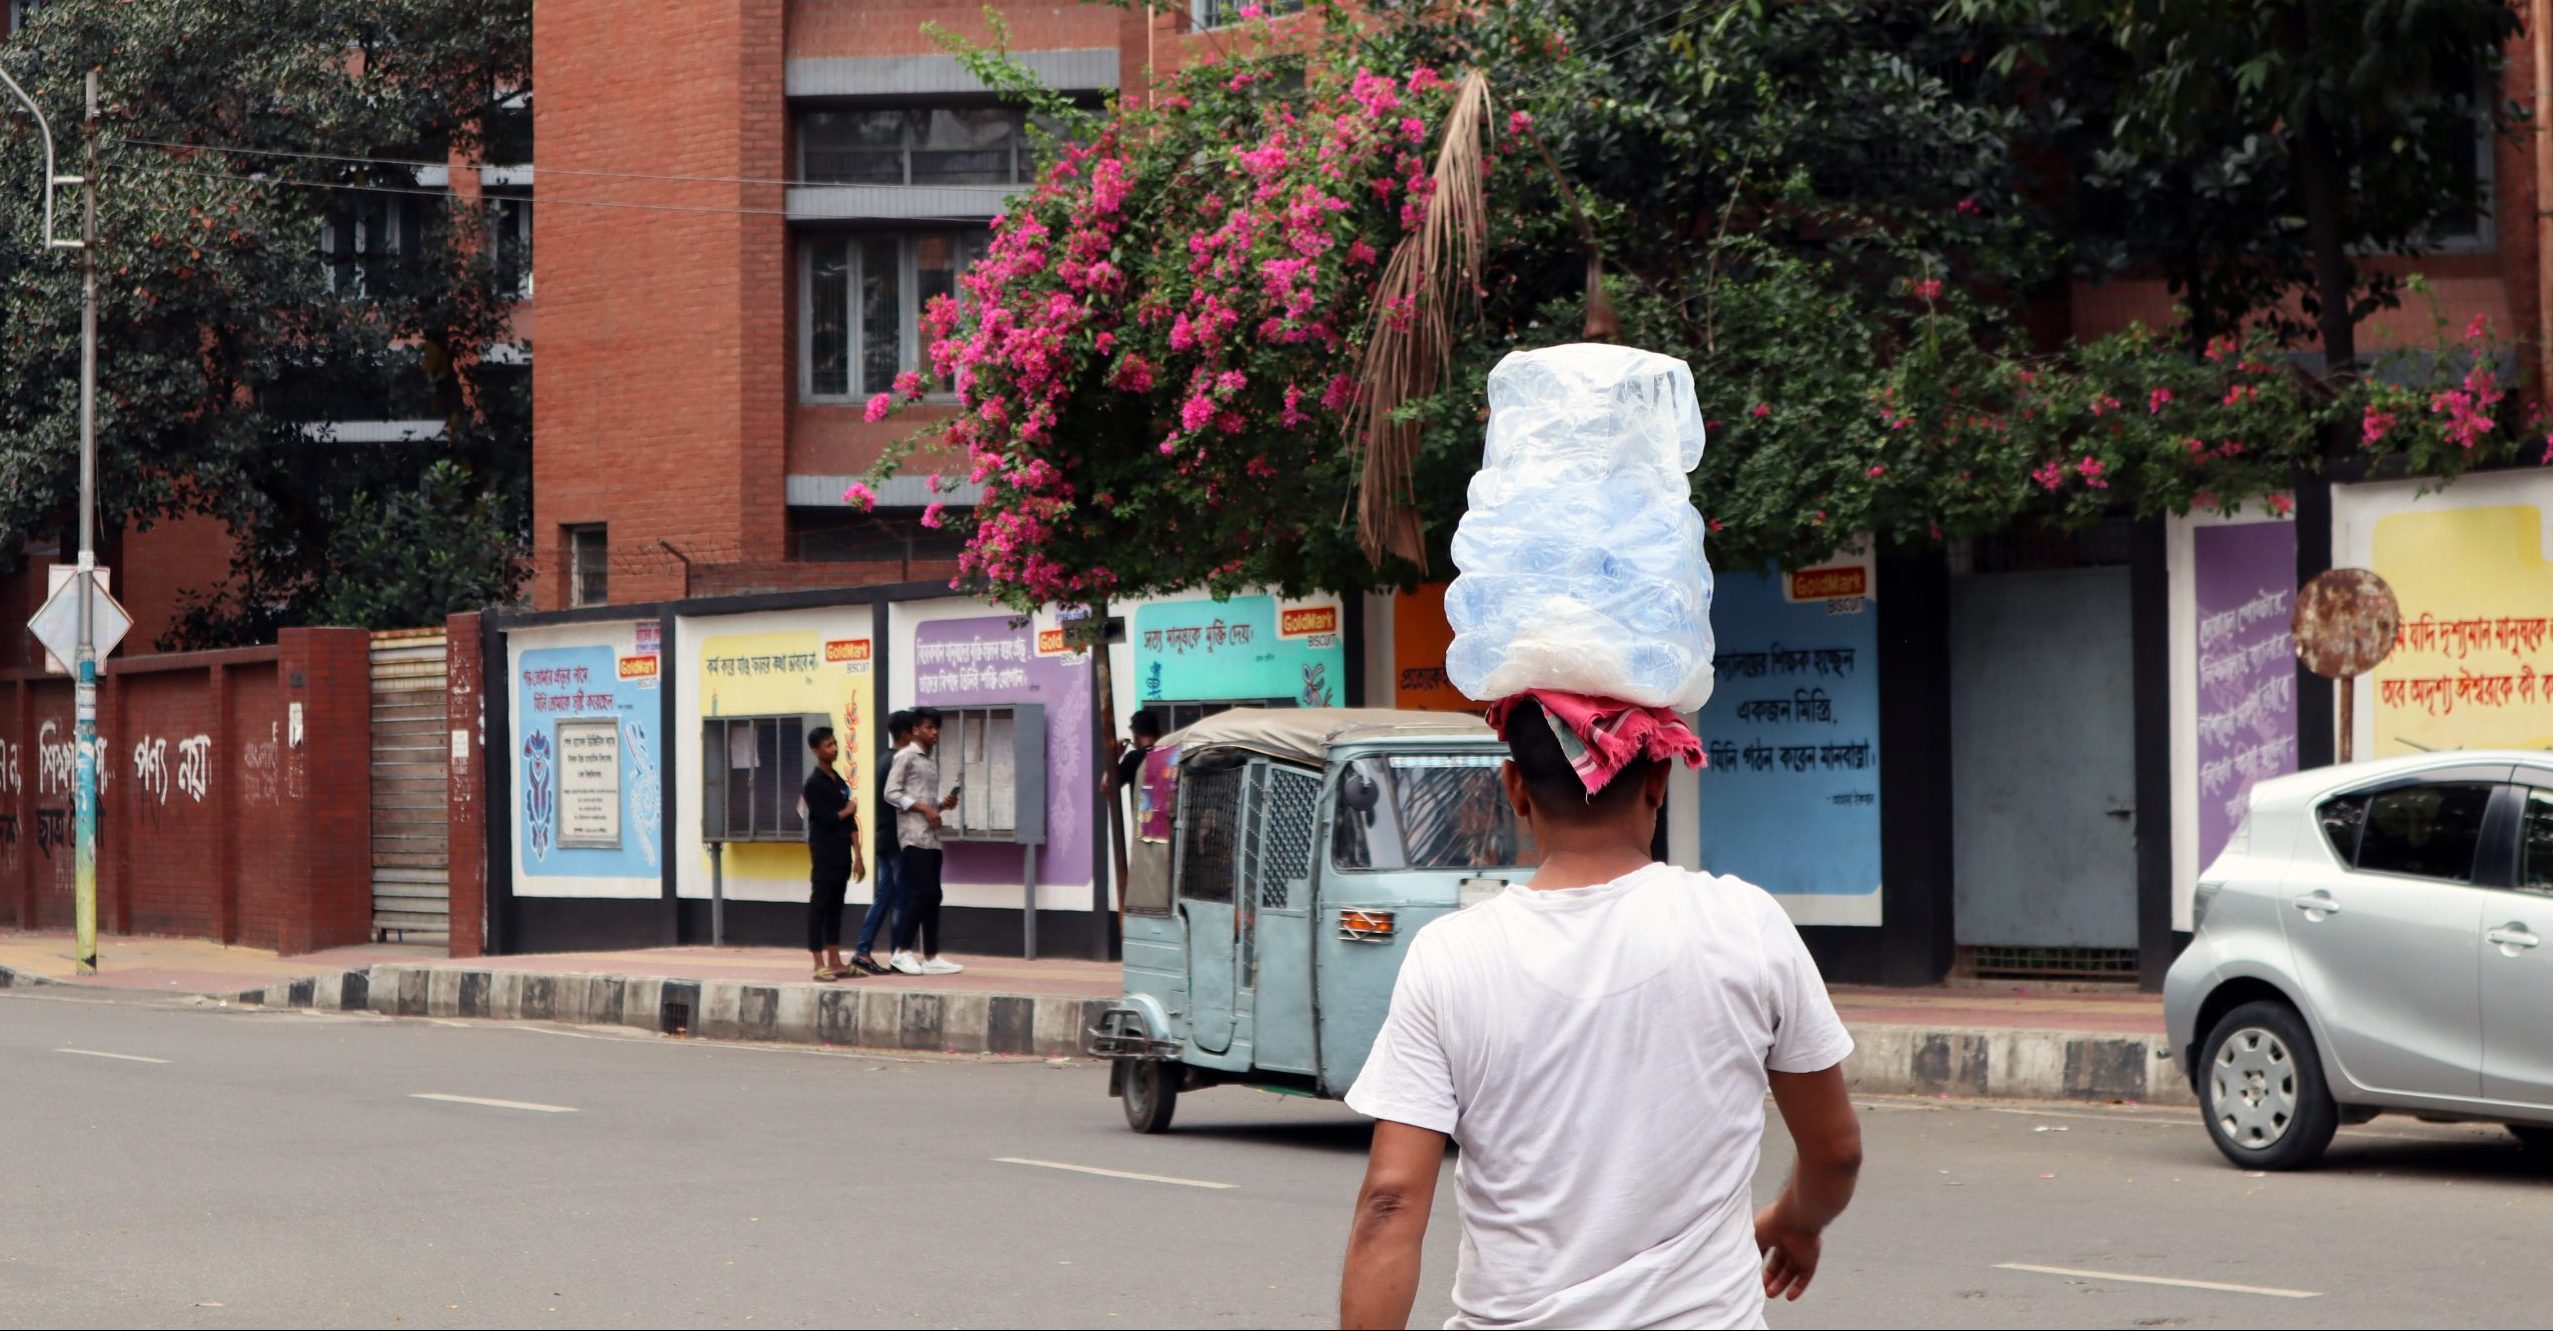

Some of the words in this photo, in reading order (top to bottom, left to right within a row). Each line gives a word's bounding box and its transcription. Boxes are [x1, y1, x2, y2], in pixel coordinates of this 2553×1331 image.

[1796, 572, 1862, 596] GoldMark
[1143, 630, 1163, 653] সত্য
[1166, 626, 1202, 655] মানুষকে
[1205, 618, 1226, 655] মুক্তি
[1284, 612, 1333, 631] GoldMark
[2409, 612, 2434, 653] যদি
[2439, 617, 2491, 660] দৃশ্যমান
[2496, 616, 2546, 660] মানুষকে
[827, 643, 869, 660] GoldMark
[2381, 680, 2406, 710] তবে
[2410, 674, 2452, 716] অদৃশ্য
[2456, 667, 2513, 707] ঈশ্বরকে
[2516, 664, 2536, 704] কী
[1736, 698, 1792, 725] একজন
[134, 734, 168, 806] পণ্য
[1709, 740, 1739, 773] যিনি
